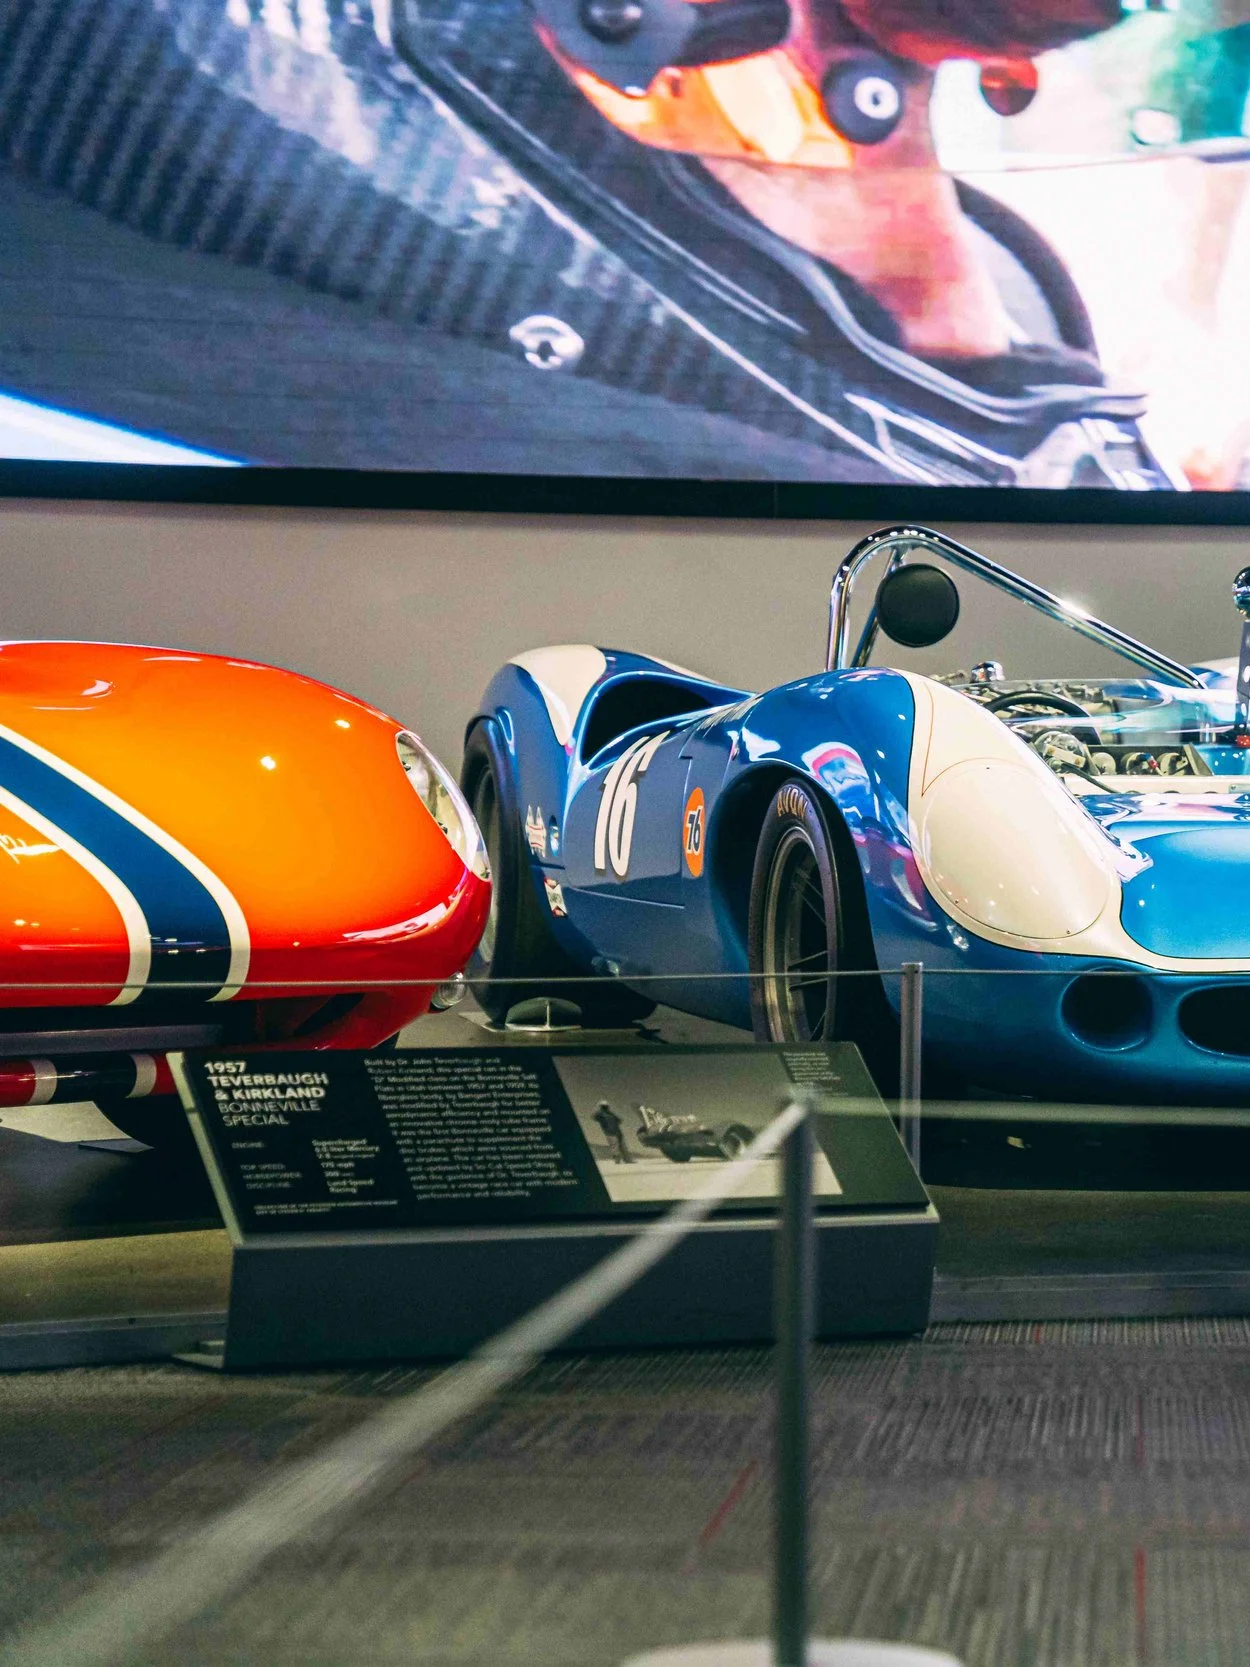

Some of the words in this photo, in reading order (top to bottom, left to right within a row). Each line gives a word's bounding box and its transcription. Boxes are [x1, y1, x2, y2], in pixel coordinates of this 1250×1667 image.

[594, 729, 672, 876] 16
[686, 805, 704, 856] 76
[204, 1061, 246, 1073] 1957
[207, 1073, 328, 1087] TEVERBAUGH
[215, 1090, 229, 1101] &
[232, 1087, 325, 1099] KIRKLAND
[219, 1101, 320, 1113] BONNEVILLE
[223, 1114, 289, 1127] SPECIAL
